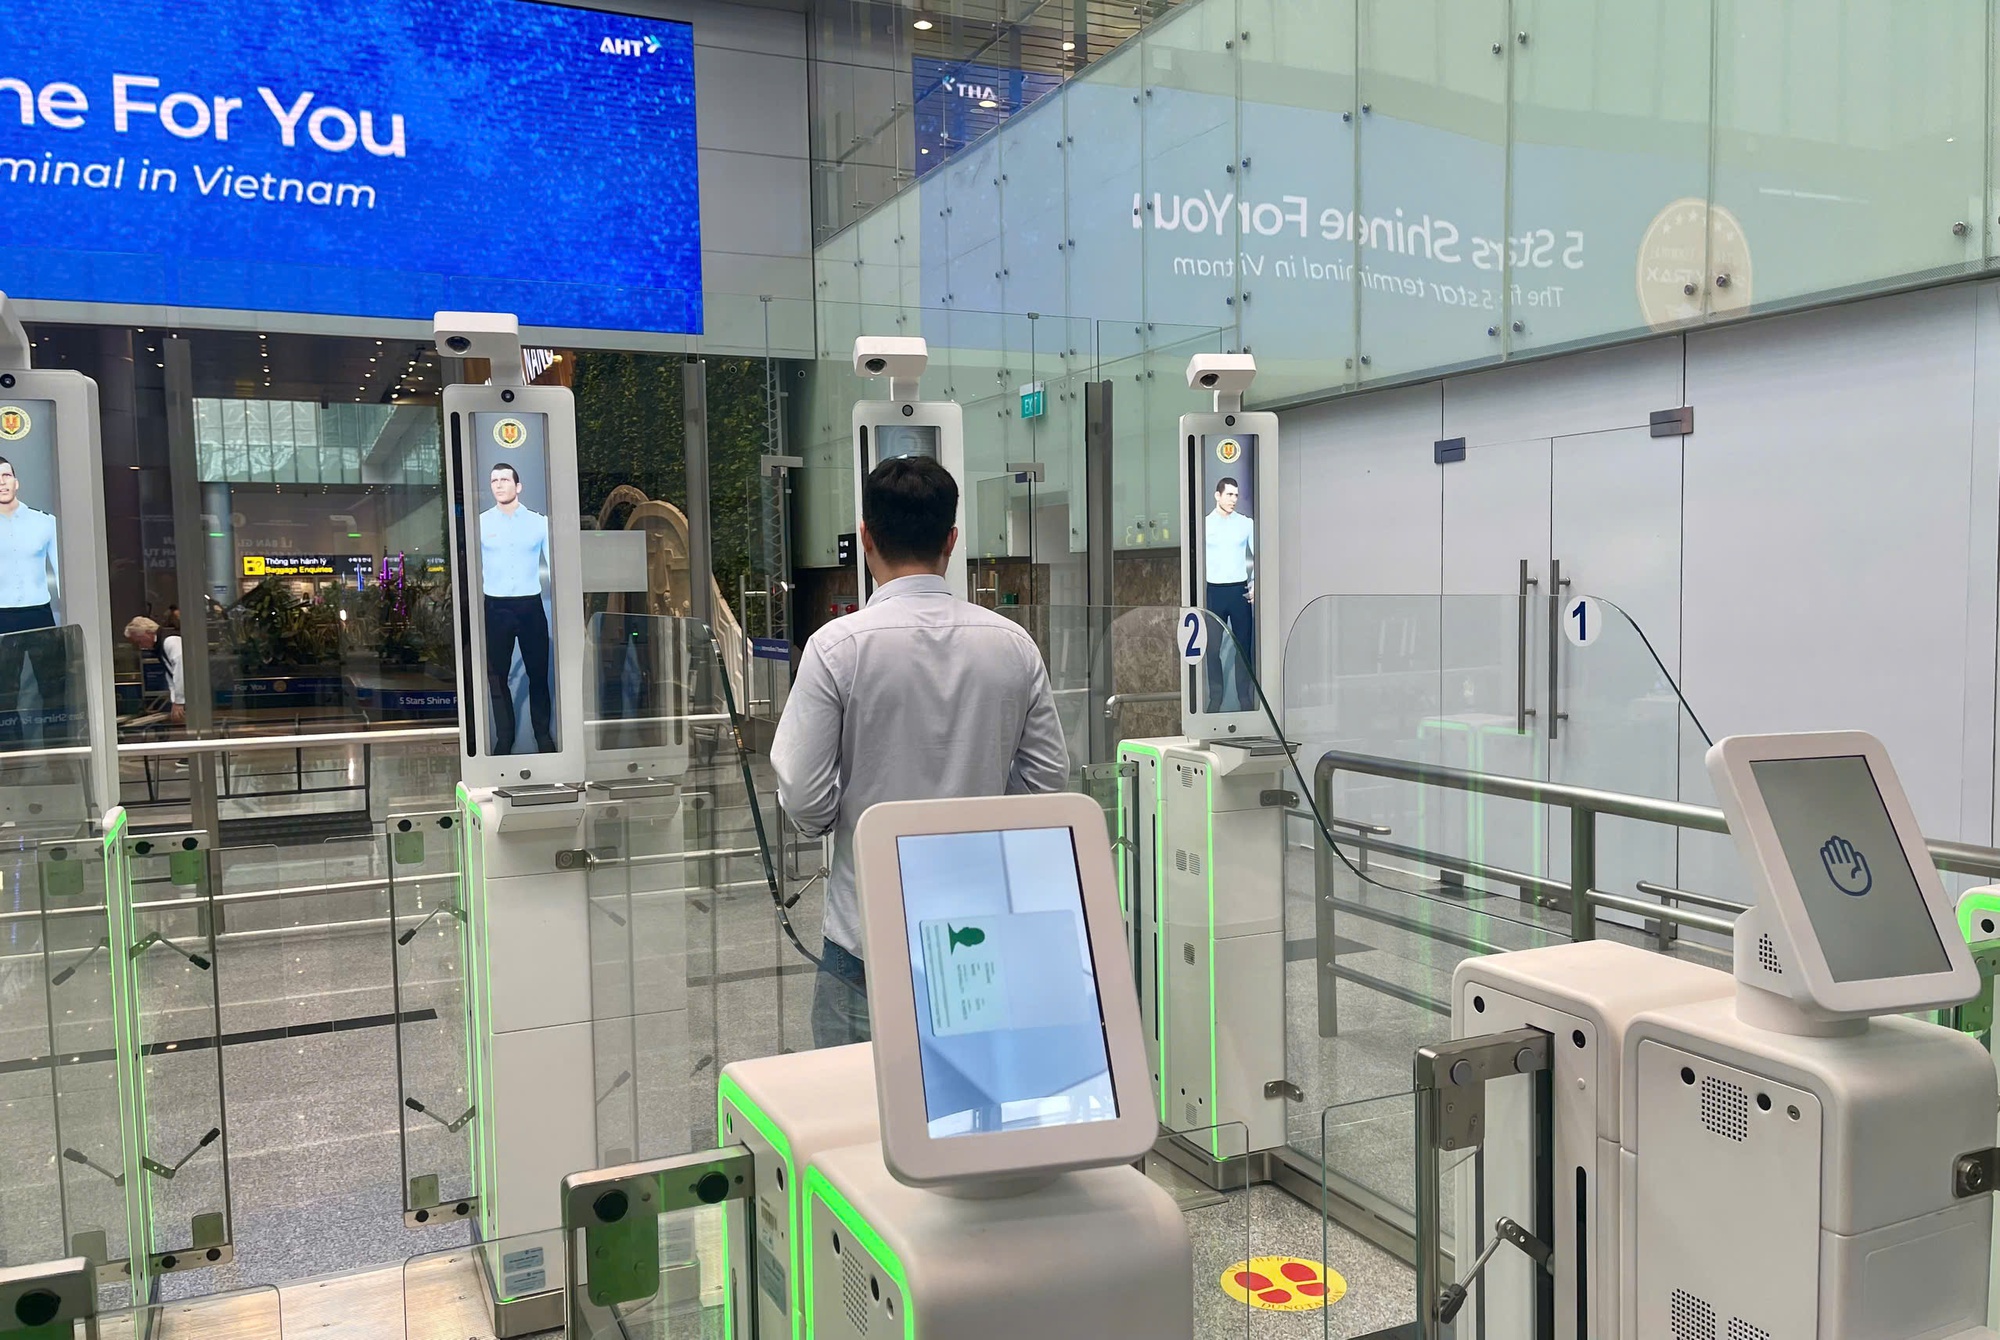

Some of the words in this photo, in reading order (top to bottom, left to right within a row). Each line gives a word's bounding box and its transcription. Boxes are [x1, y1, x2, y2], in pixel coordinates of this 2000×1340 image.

[600, 37, 643, 57] AHT
[112, 73, 242, 142] For
[257, 86, 407, 157] You
[138, 158, 178, 193] in
[193, 163, 377, 209] Vietnam
[265, 557, 288, 566] Thông
[300, 557, 319, 565] hành
[265, 566, 298, 575] Baggage
[299, 566, 334, 574] Enquiries
[1183, 612, 1202, 658] 2
[1570, 600, 1588, 642] 1
[405, 696, 425, 705] Stars
[426, 696, 451, 705] Shine
